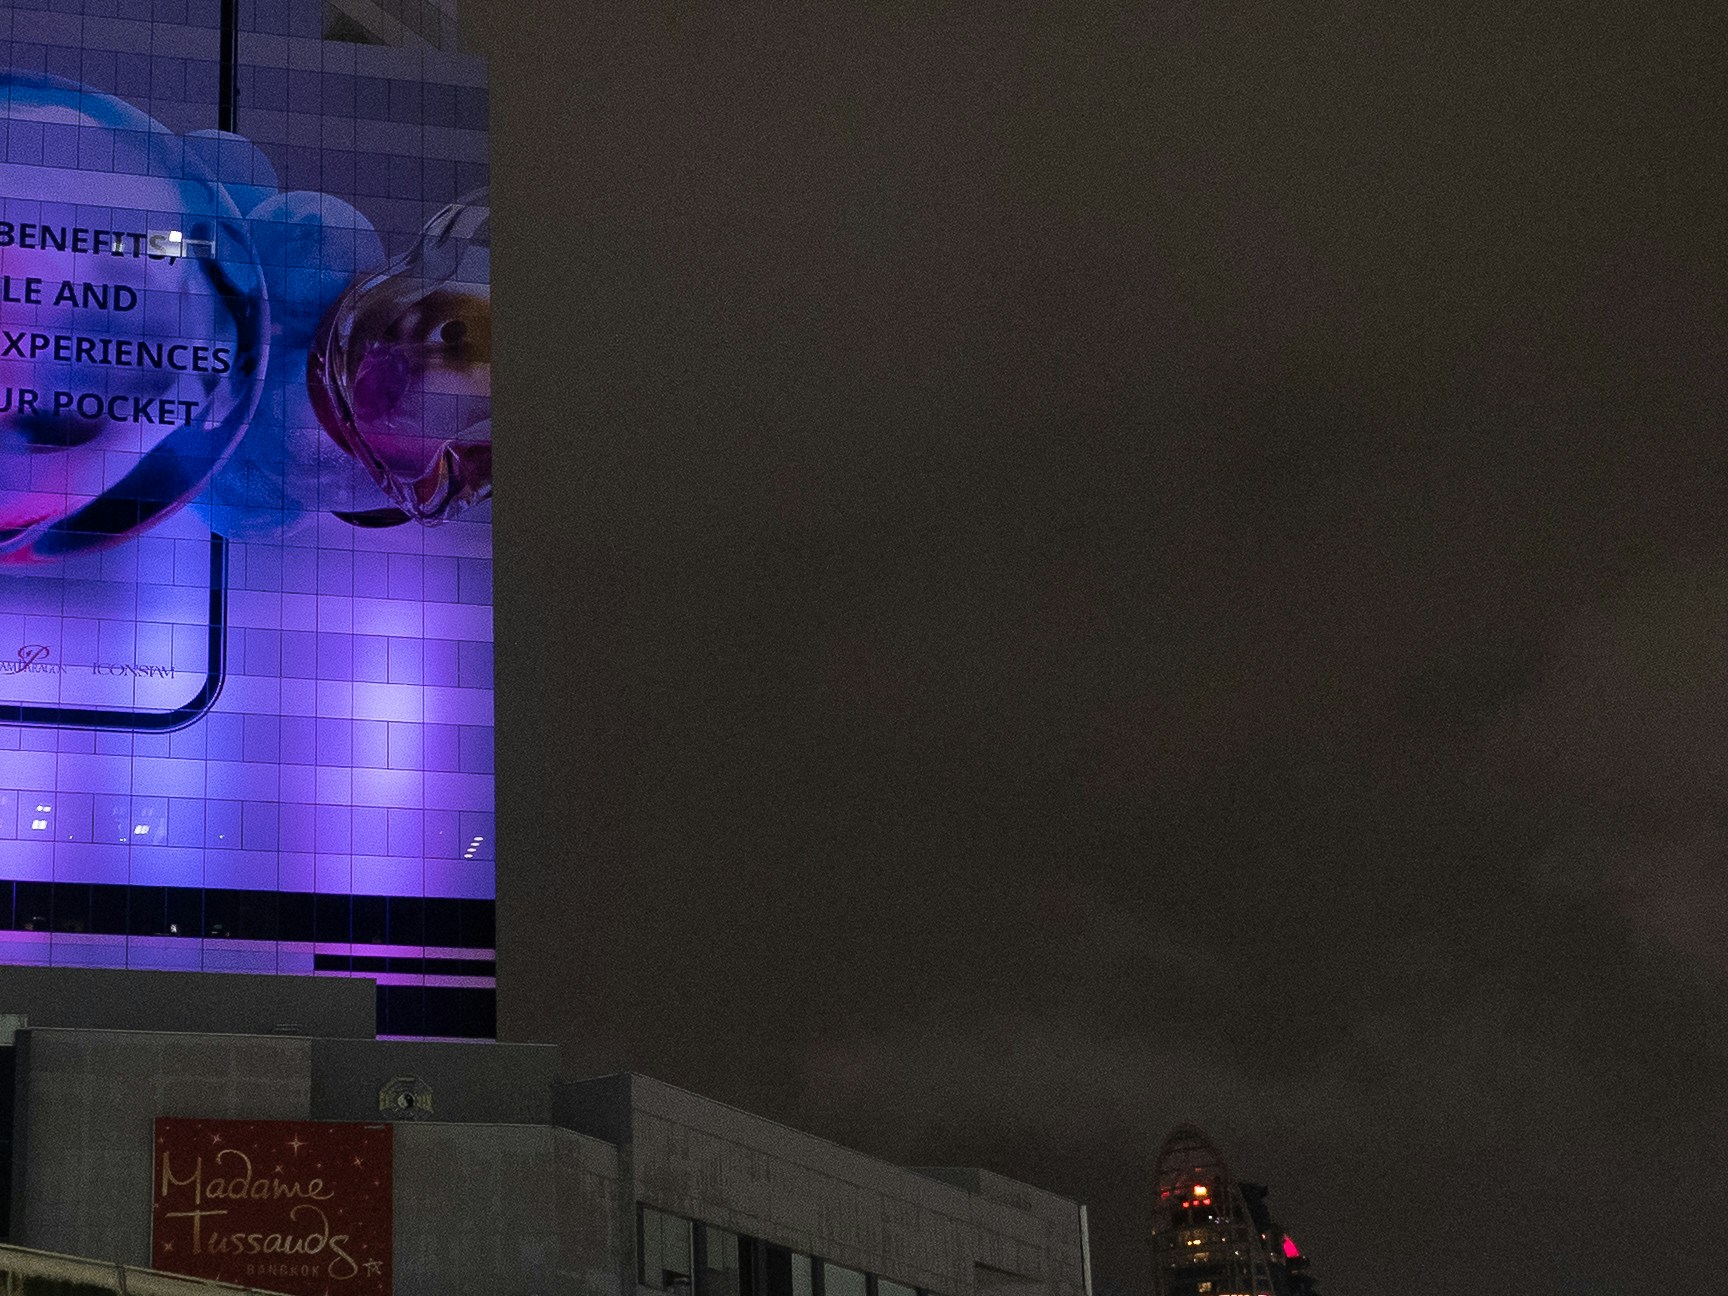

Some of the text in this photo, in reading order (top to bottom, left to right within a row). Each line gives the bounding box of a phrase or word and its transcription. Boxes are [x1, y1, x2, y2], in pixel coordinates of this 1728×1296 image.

[53, 283, 138, 312] AND
[52, 391, 200, 427] POCKET
[160, 1149, 335, 1204] Madame
[165, 1204, 359, 1280] Tussauds
